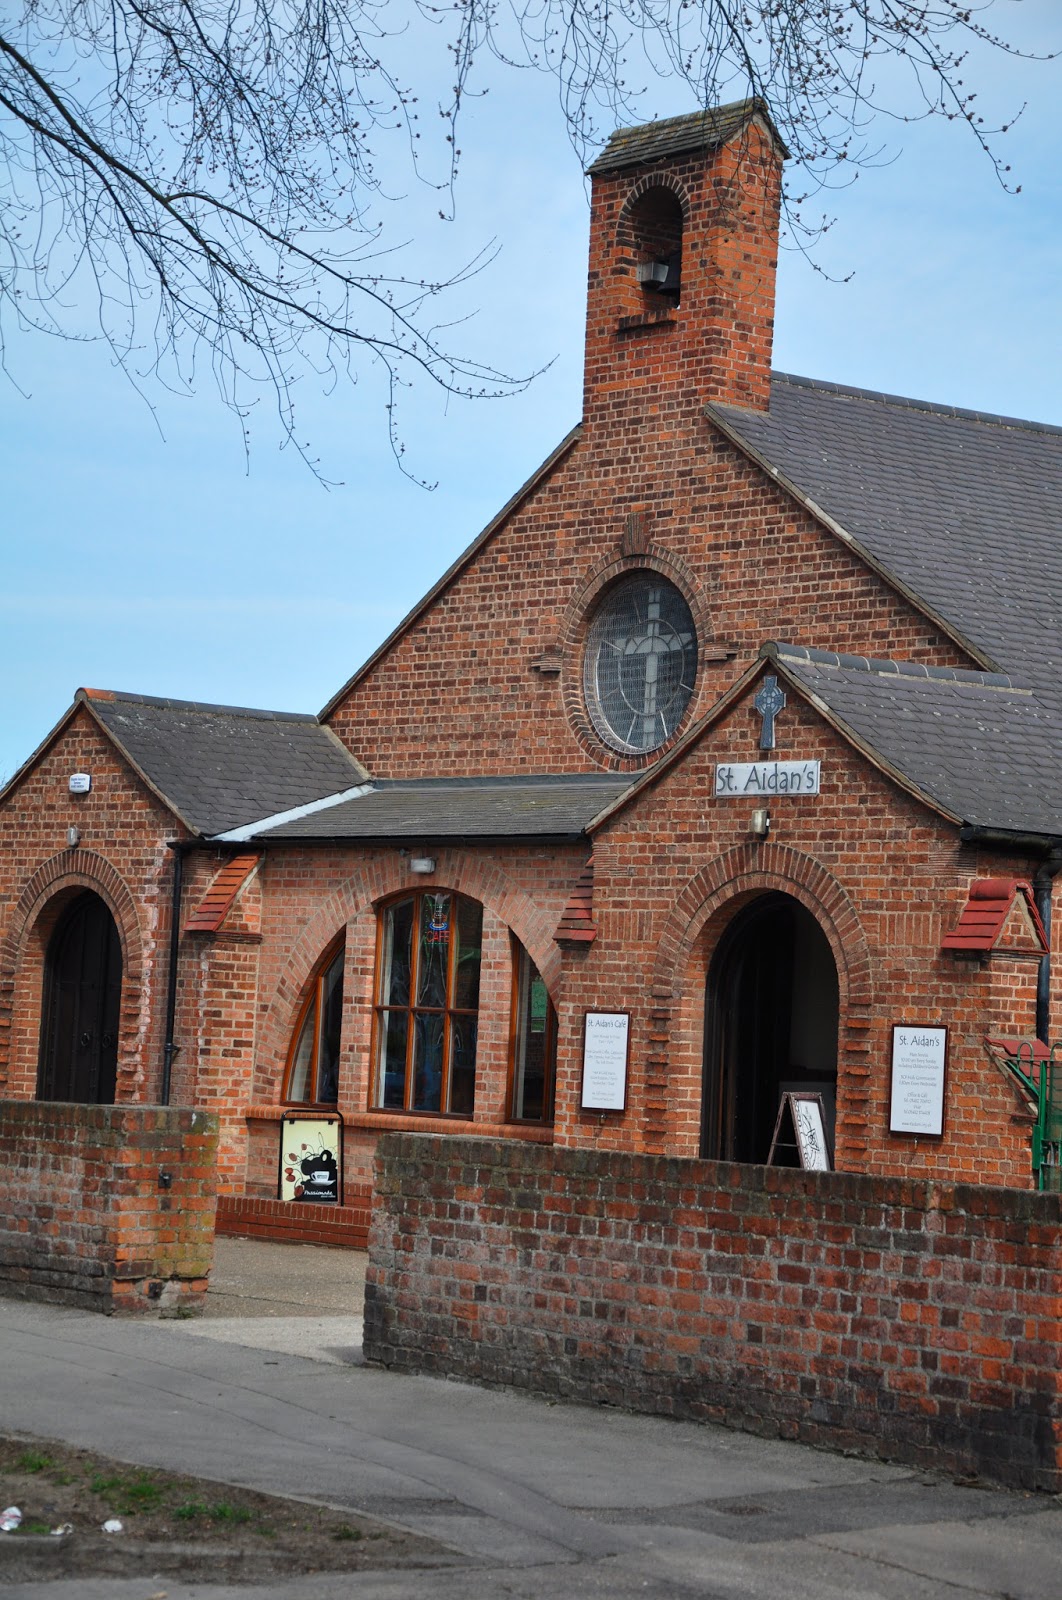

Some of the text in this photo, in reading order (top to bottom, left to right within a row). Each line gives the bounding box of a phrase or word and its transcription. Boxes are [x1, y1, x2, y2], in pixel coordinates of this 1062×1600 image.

[716, 762, 815, 794] St. Aidan's
[426, 930, 450, 943] CAFE
[899, 1035, 940, 1047] St. Aidan's
